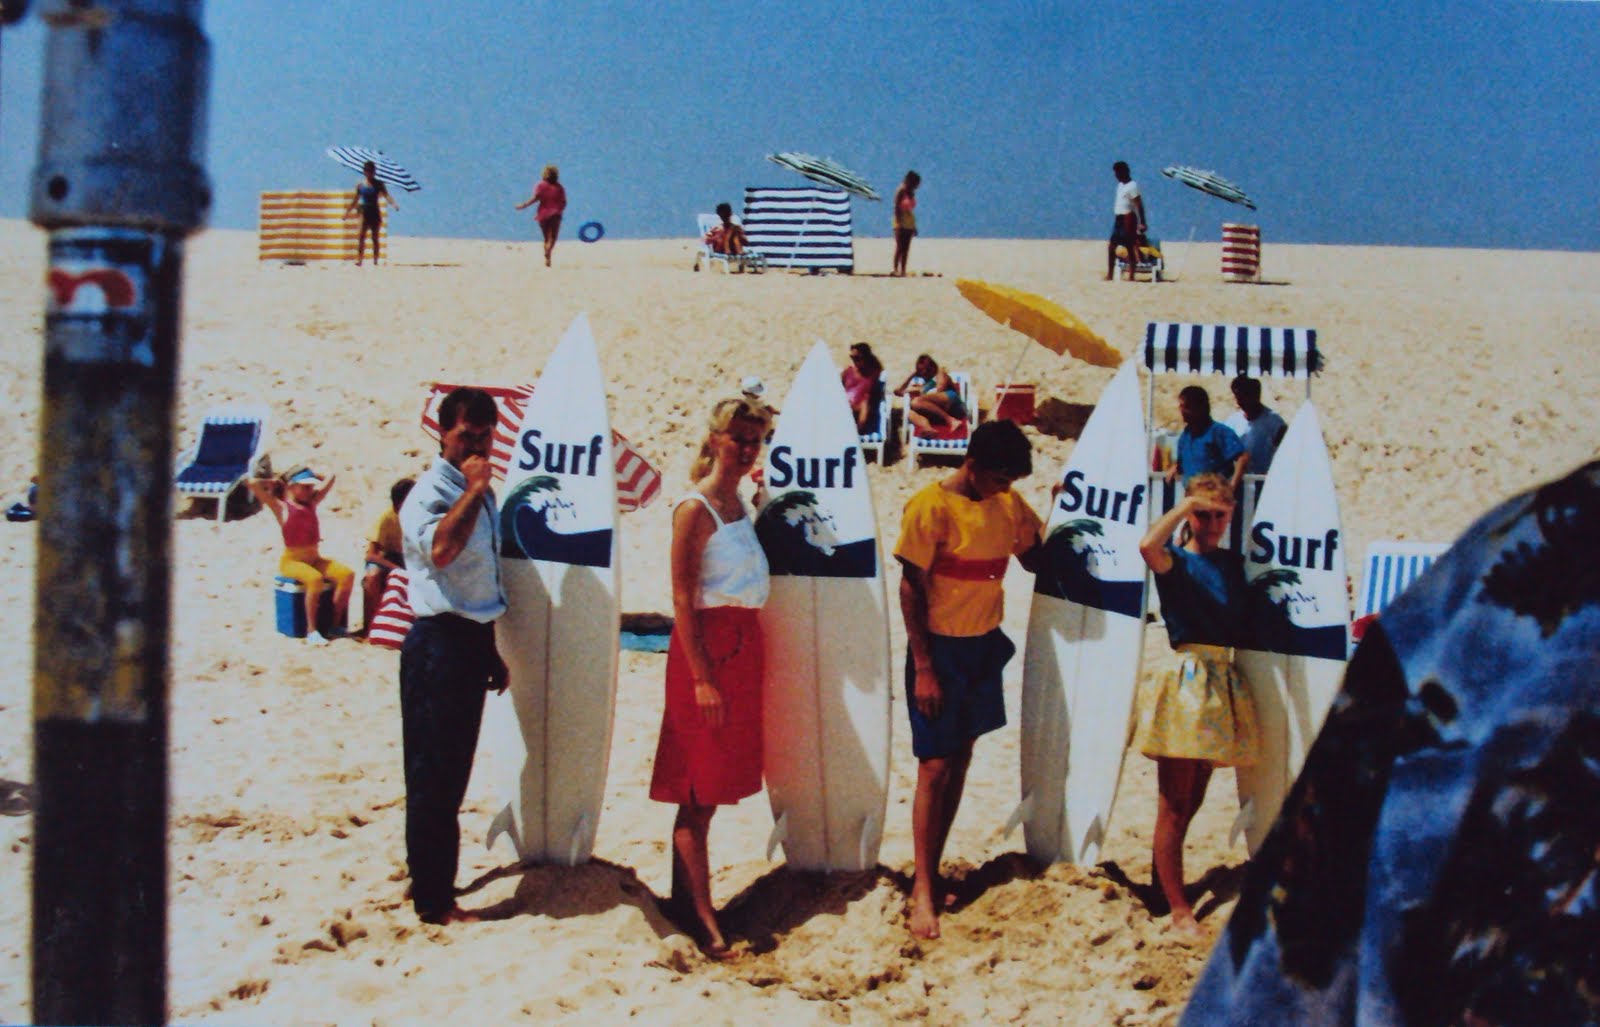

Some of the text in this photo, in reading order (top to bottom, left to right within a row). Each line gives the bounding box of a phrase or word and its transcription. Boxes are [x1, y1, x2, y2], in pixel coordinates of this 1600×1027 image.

[519, 429, 603, 476] Surf
[769, 446, 857, 488] Surf
[1059, 470, 1145, 525] Surf
[1251, 521, 1338, 571] Surf
